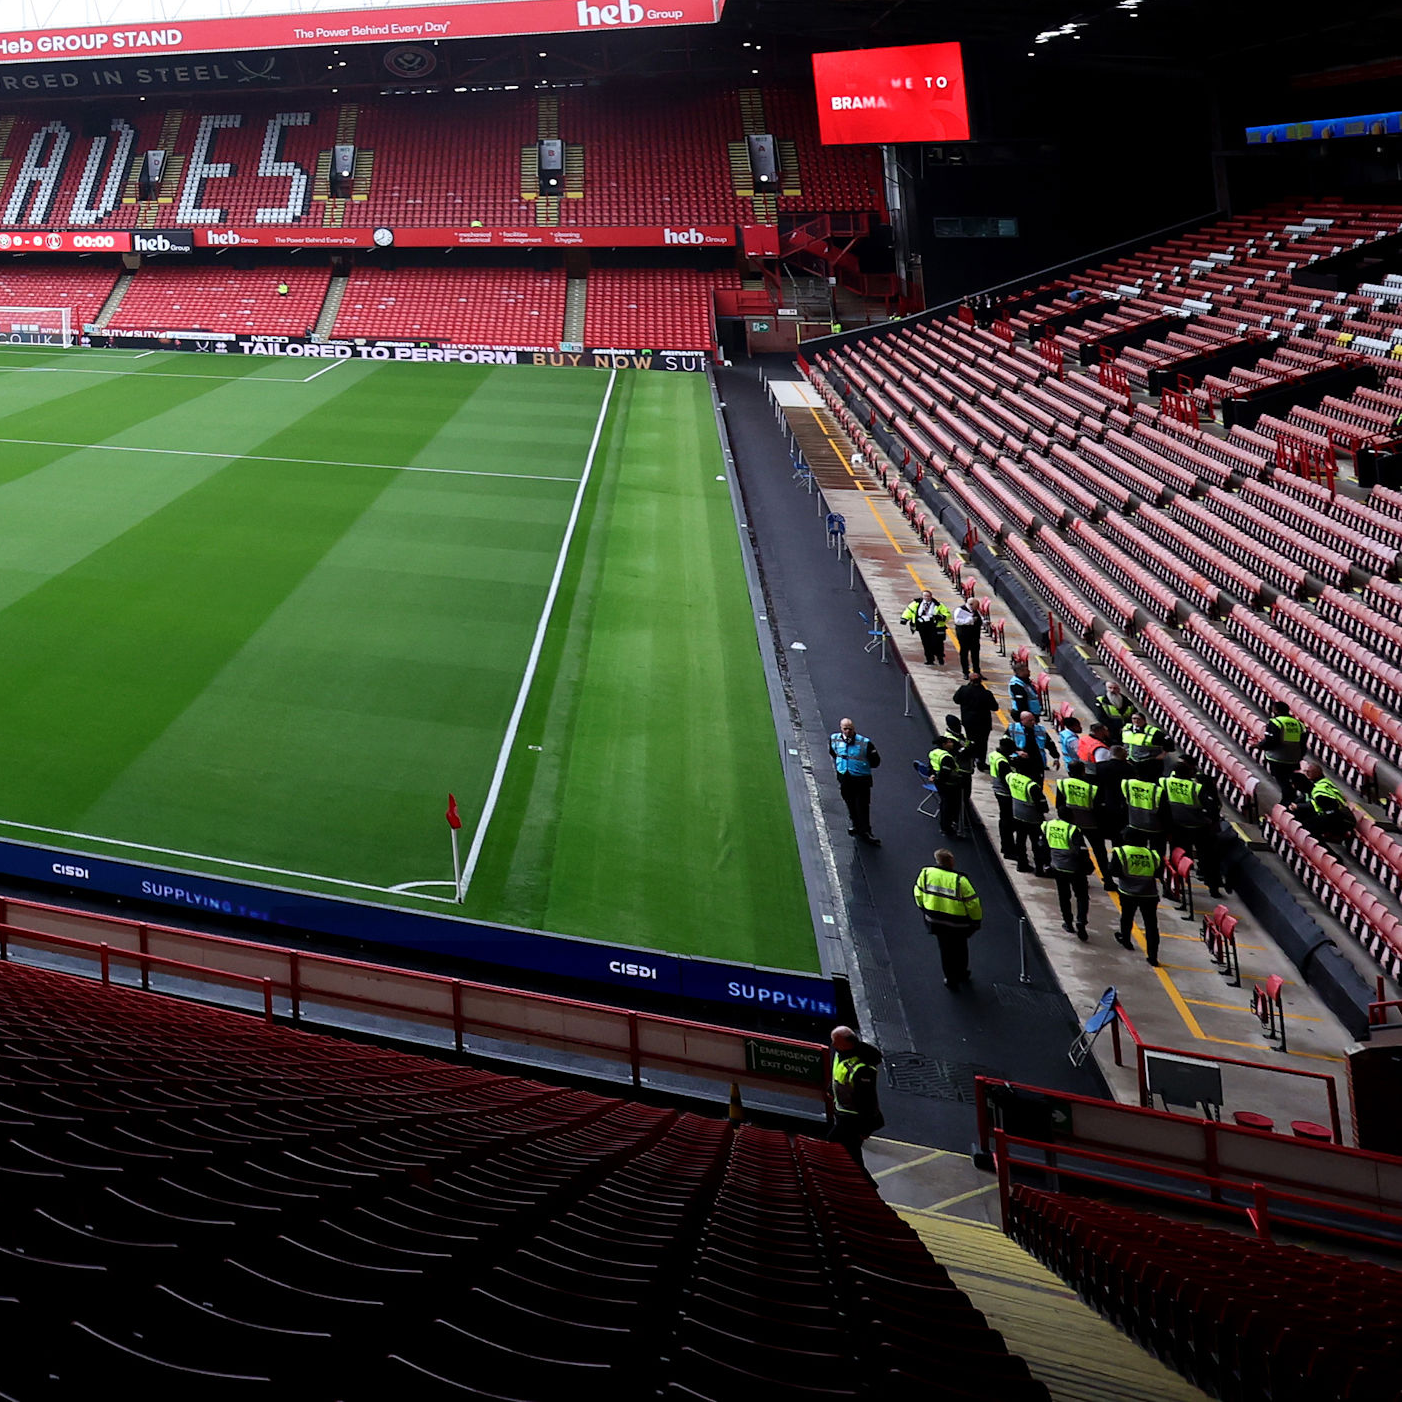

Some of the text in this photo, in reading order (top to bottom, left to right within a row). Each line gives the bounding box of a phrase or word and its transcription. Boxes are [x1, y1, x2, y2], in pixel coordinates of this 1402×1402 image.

[646, 9, 684, 21] Group
[294, 29, 314, 40] The
[316, 28, 350, 38] Power
[352, 24, 389, 37] Behind
[391, 23, 423, 35] Every
[36, 33, 109, 52] GROUP
[112, 29, 183, 47] STAND
[92, 70, 123, 86] IN
[137, 64, 229, 84] STEEL
[924, 76, 948, 89] TO
[13, 236, 23, 246] 0
[33, 236, 43, 246] 0
[73, 236, 115, 247] 00:00
[134, 235, 191, 252] heb Group
[207, 230, 259, 245] heb Group
[663, 228, 728, 244] heb Group
[102, 329, 127, 337] SUTV
[134, 330, 159, 338] SUTV
[251, 335, 289, 343] NOCO
[239, 341, 517, 365] TAILORED TO PERFORM
[533, 351, 652, 370] BUY NOW
[52, 862, 90, 879] CISDI
[141, 880, 232, 914] SUPPLYING
[609, 960, 656, 979] CISDI
[759, 1046, 821, 1063] EMERGENCY
[760, 1058, 810, 1075] EXIT ONLY
